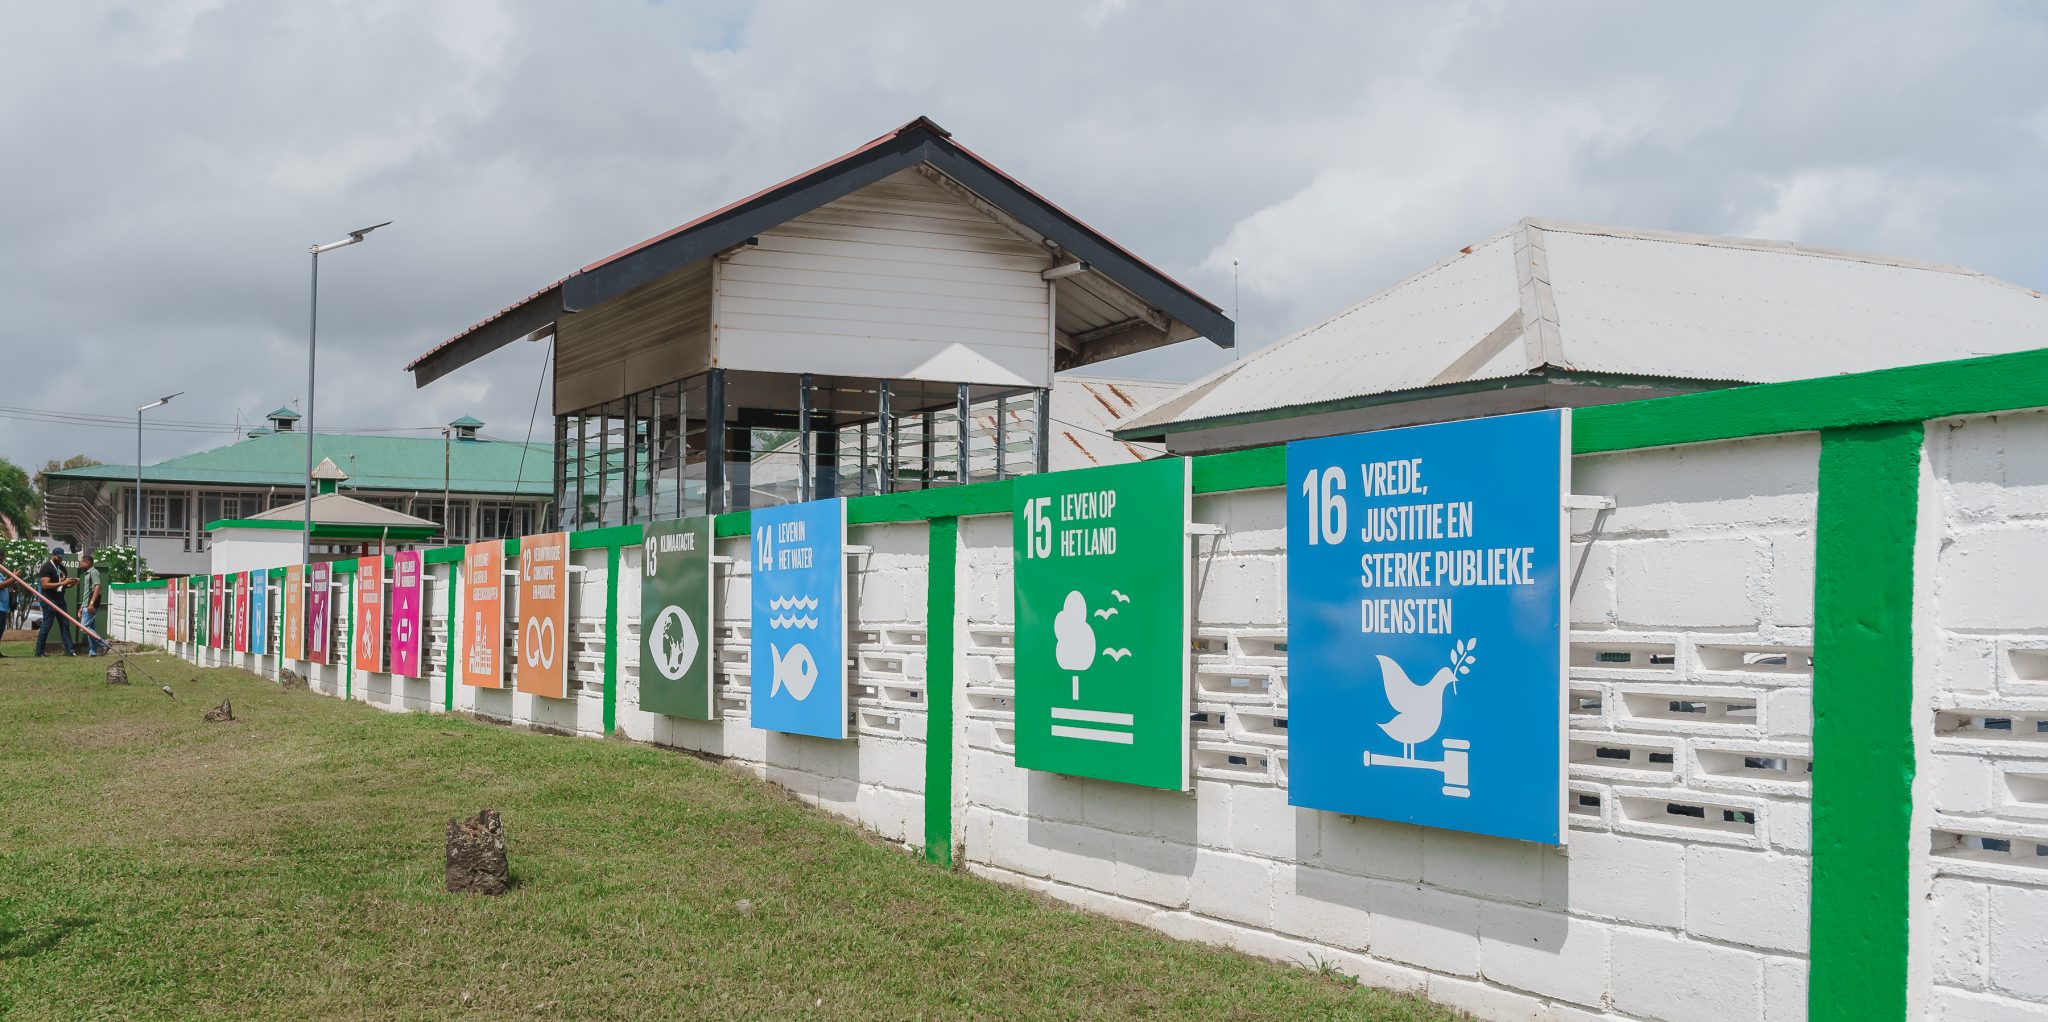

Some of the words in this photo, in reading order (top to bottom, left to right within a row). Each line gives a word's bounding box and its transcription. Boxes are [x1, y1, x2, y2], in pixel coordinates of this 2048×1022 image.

[1361, 458, 1428, 497] VREDE,
[1060, 491, 1097, 522] LEVEN
[1100, 490, 1116, 519] OP
[1302, 466, 1347, 545] 16
[1361, 503, 1443, 543] JUSTITIE
[1447, 501, 1473, 539] EN
[660, 532, 695, 553] KLIMAATACTIE
[778, 521, 799, 544] LEVEN
[799, 520, 806, 541] IN
[1024, 497, 1052, 559] 15
[1060, 530, 1083, 557] HET
[1084, 527, 1117, 556] LAND
[523, 547, 531, 582] 12
[645, 536, 657, 577] 13
[757, 525, 773, 572] 14
[778, 549, 791, 570] HET
[792, 547, 813, 569] WATER
[1361, 552, 1432, 588] STERKE
[1436, 547, 1535, 587] PUBLIEKE
[1361, 599, 1452, 634] DIENSTEN
